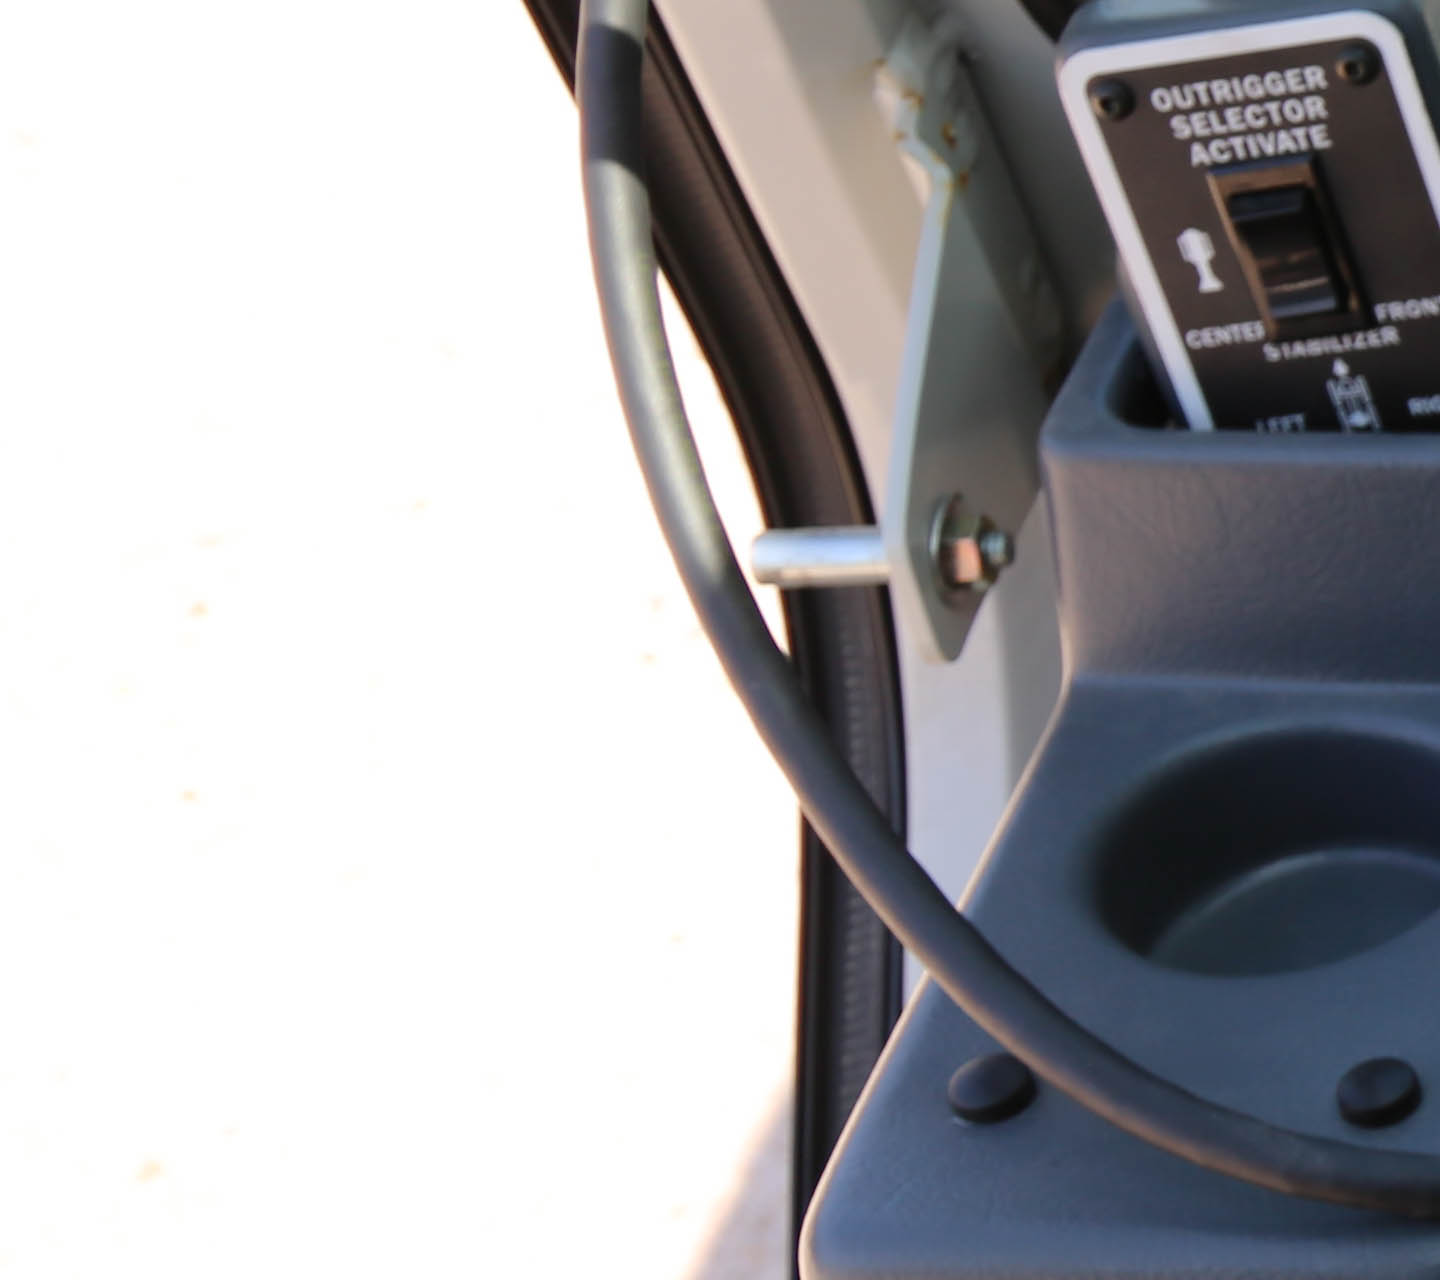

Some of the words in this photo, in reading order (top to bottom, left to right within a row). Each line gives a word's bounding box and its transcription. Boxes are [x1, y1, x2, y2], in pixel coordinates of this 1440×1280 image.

[1151, 65, 1328, 114] OUTRIGGER
[1169, 96, 1328, 140] SELECTOR
[1190, 126, 1332, 167] ACTIVATE
[1262, 325, 1401, 362] STABILIZER
